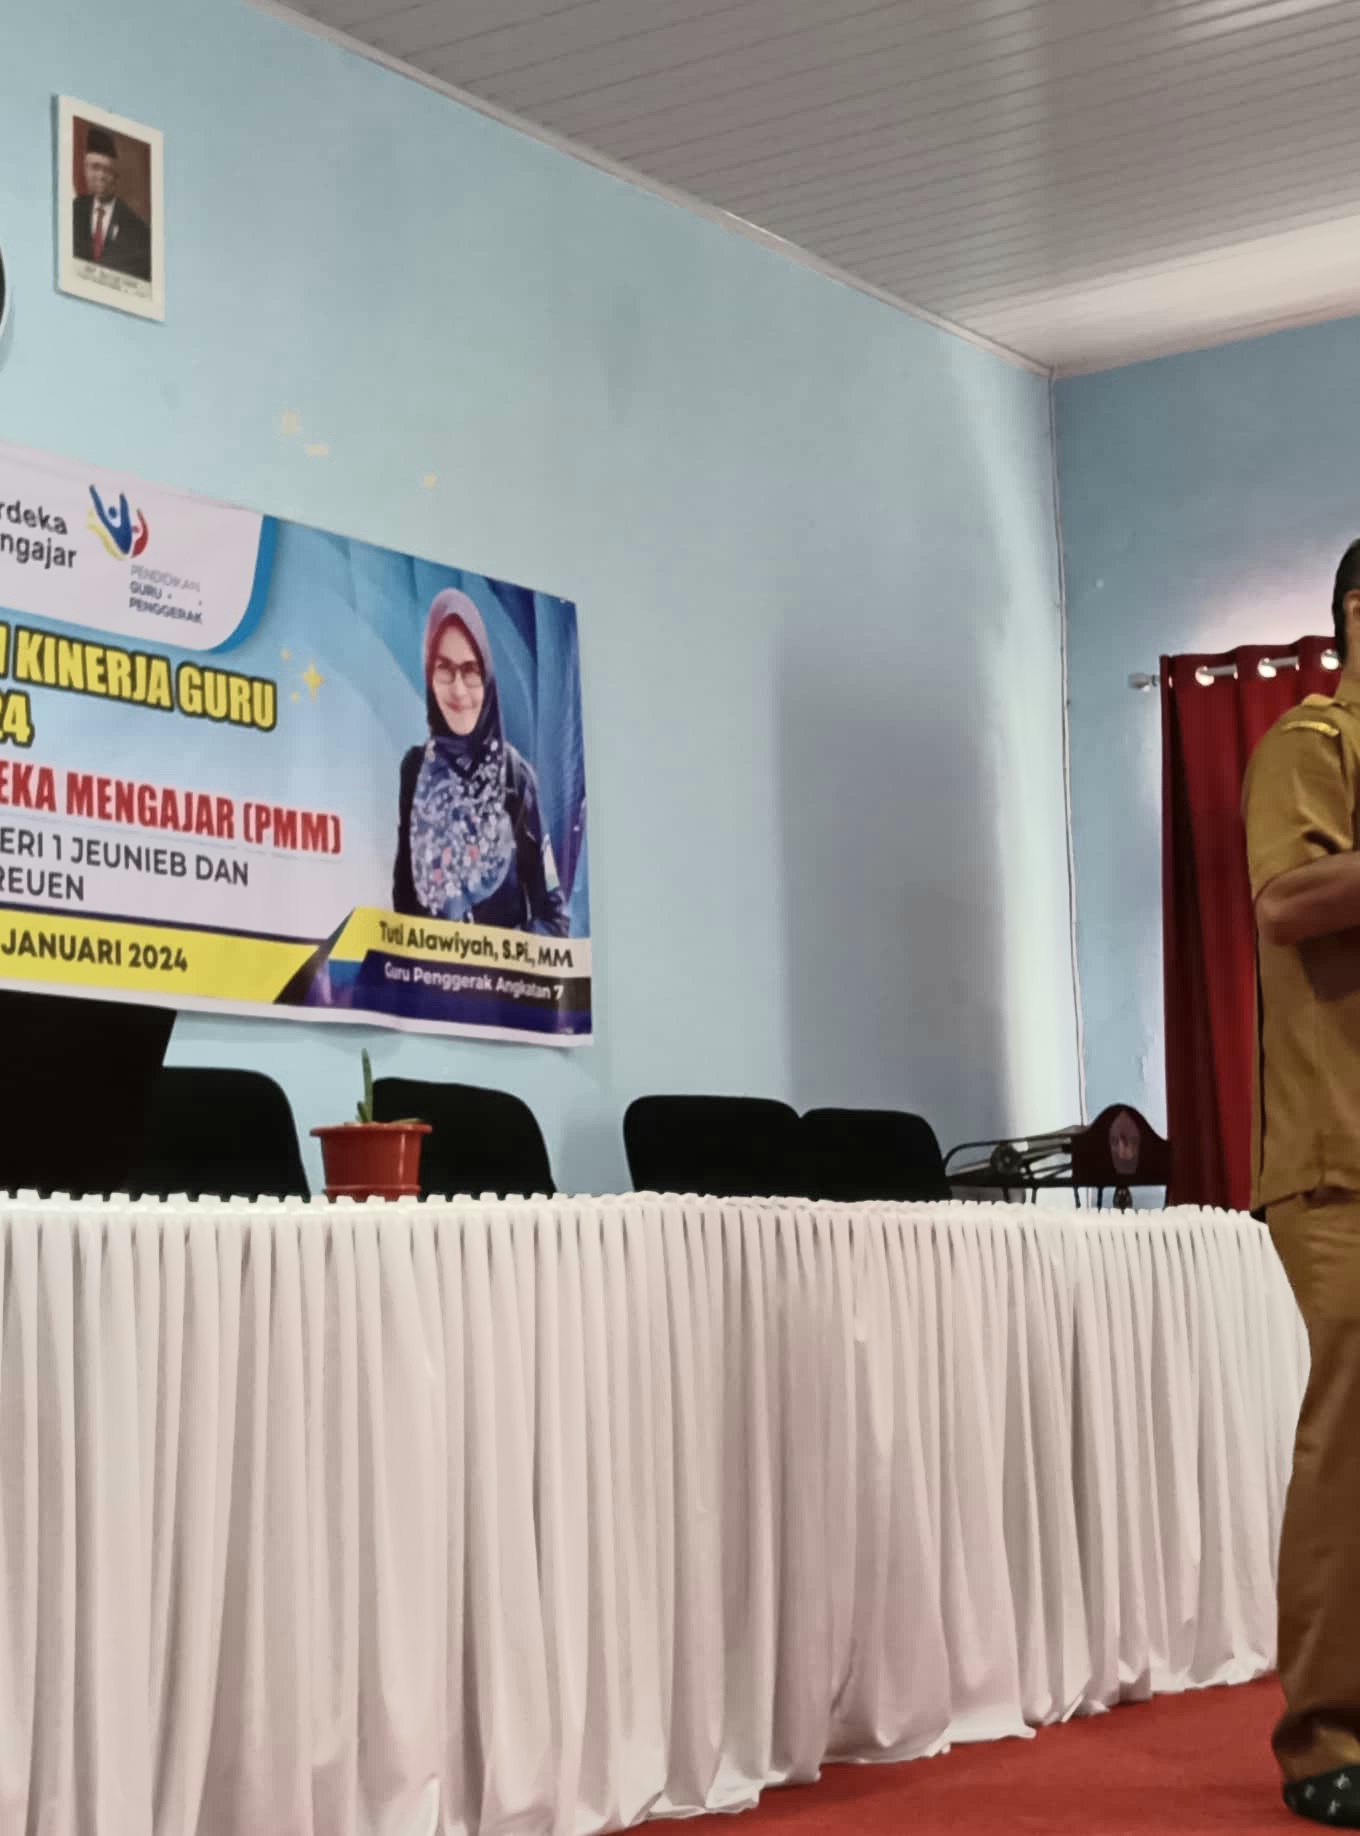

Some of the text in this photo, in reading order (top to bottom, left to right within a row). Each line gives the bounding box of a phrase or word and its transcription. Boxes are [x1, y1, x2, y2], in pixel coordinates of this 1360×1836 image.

[129, 596, 203, 625] PENGGERAK
[130, 580, 162, 600] GURU
[13, 625, 174, 711] KINERJA
[176, 661, 277, 731] GURU
[66, 771, 235, 840] MENGAJAR
[242, 802, 341, 855] (PMM)
[52, 834, 62, 861] 1
[71, 837, 187, 878] JEUNIEB
[196, 854, 248, 886] DAN
[1, 929, 122, 965] JANUARI
[128, 943, 188, 972] 2024
[378, 921, 404, 946] Tuti
[407, 927, 498, 960] Alawiyah,
[537, 947, 574, 968] MM
[385, 961, 564, 1000] Guru Penggerak Angkatan 7
